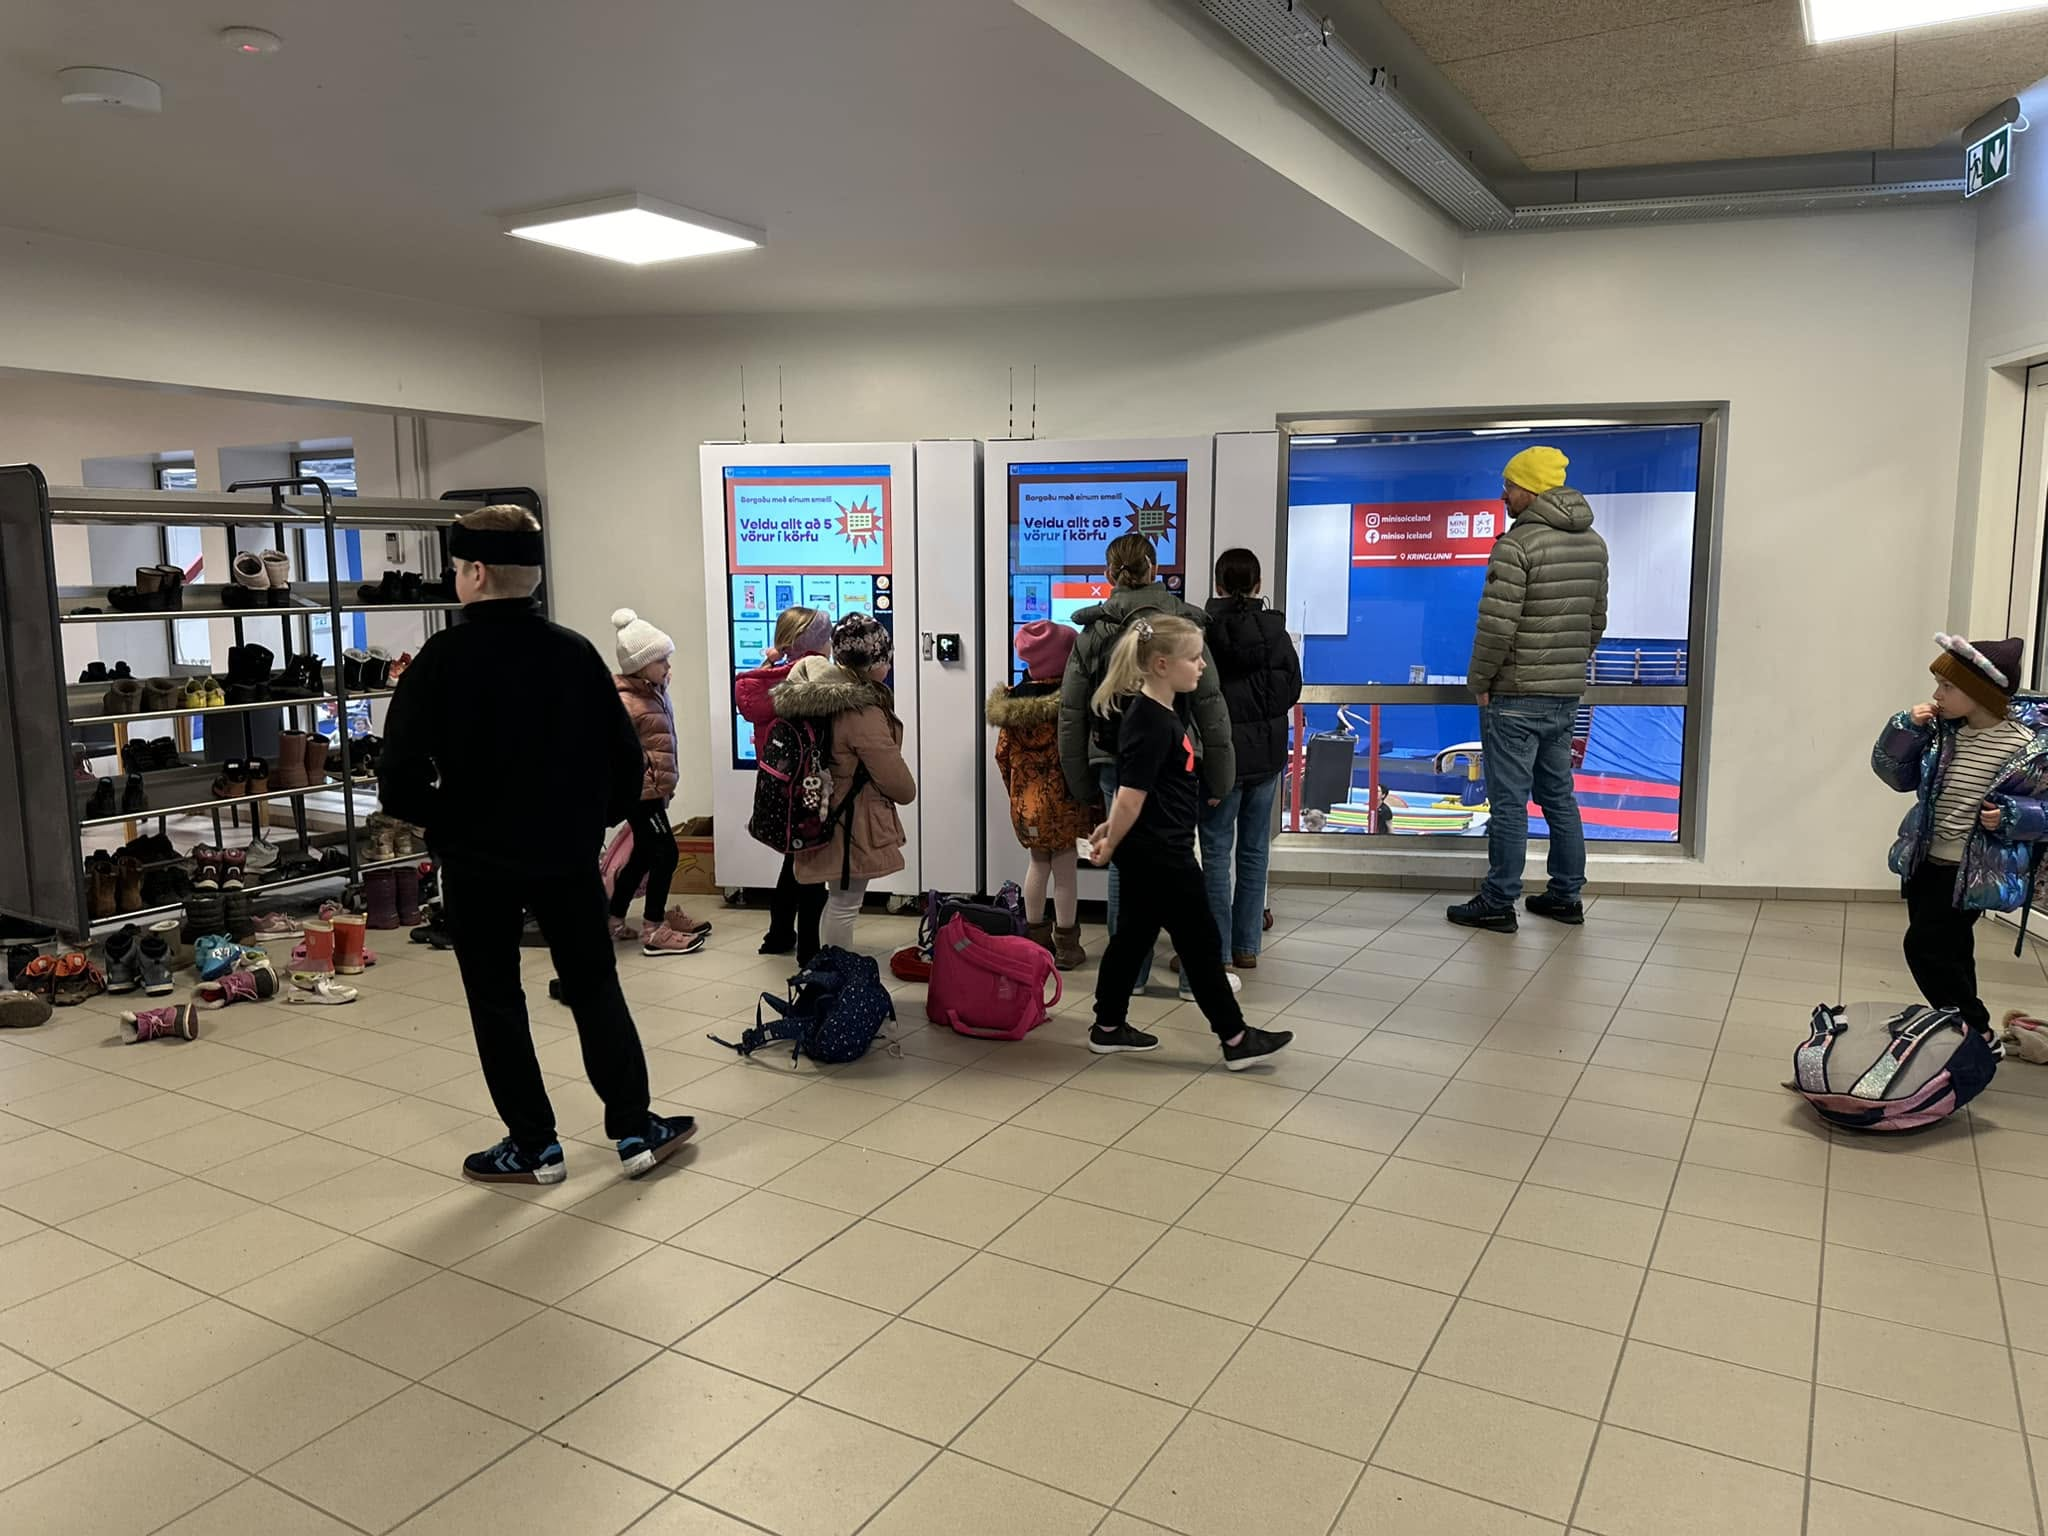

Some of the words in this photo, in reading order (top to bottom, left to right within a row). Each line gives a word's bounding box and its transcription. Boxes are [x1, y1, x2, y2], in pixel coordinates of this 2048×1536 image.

[740, 518, 778, 529] Veldu
[781, 518, 802, 529] allt
[804, 518, 821, 529] að
[824, 518, 832, 529] 5
[1024, 516, 1064, 528] Veldu
[1066, 516, 1090, 528] allt
[1092, 516, 1110, 528] að
[1112, 516, 1122, 528] 5
[1381, 514, 1431, 523] minisoiceland
[740, 530, 775, 542] vörur
[783, 530, 819, 542] körfu
[1024, 529, 1060, 541] vörur
[1069, 529, 1107, 541] körfu
[1380, 532, 1405, 540] miniso
[1406, 531, 1432, 539] iceland
[1406, 552, 1453, 561] KRINGLUNNI
